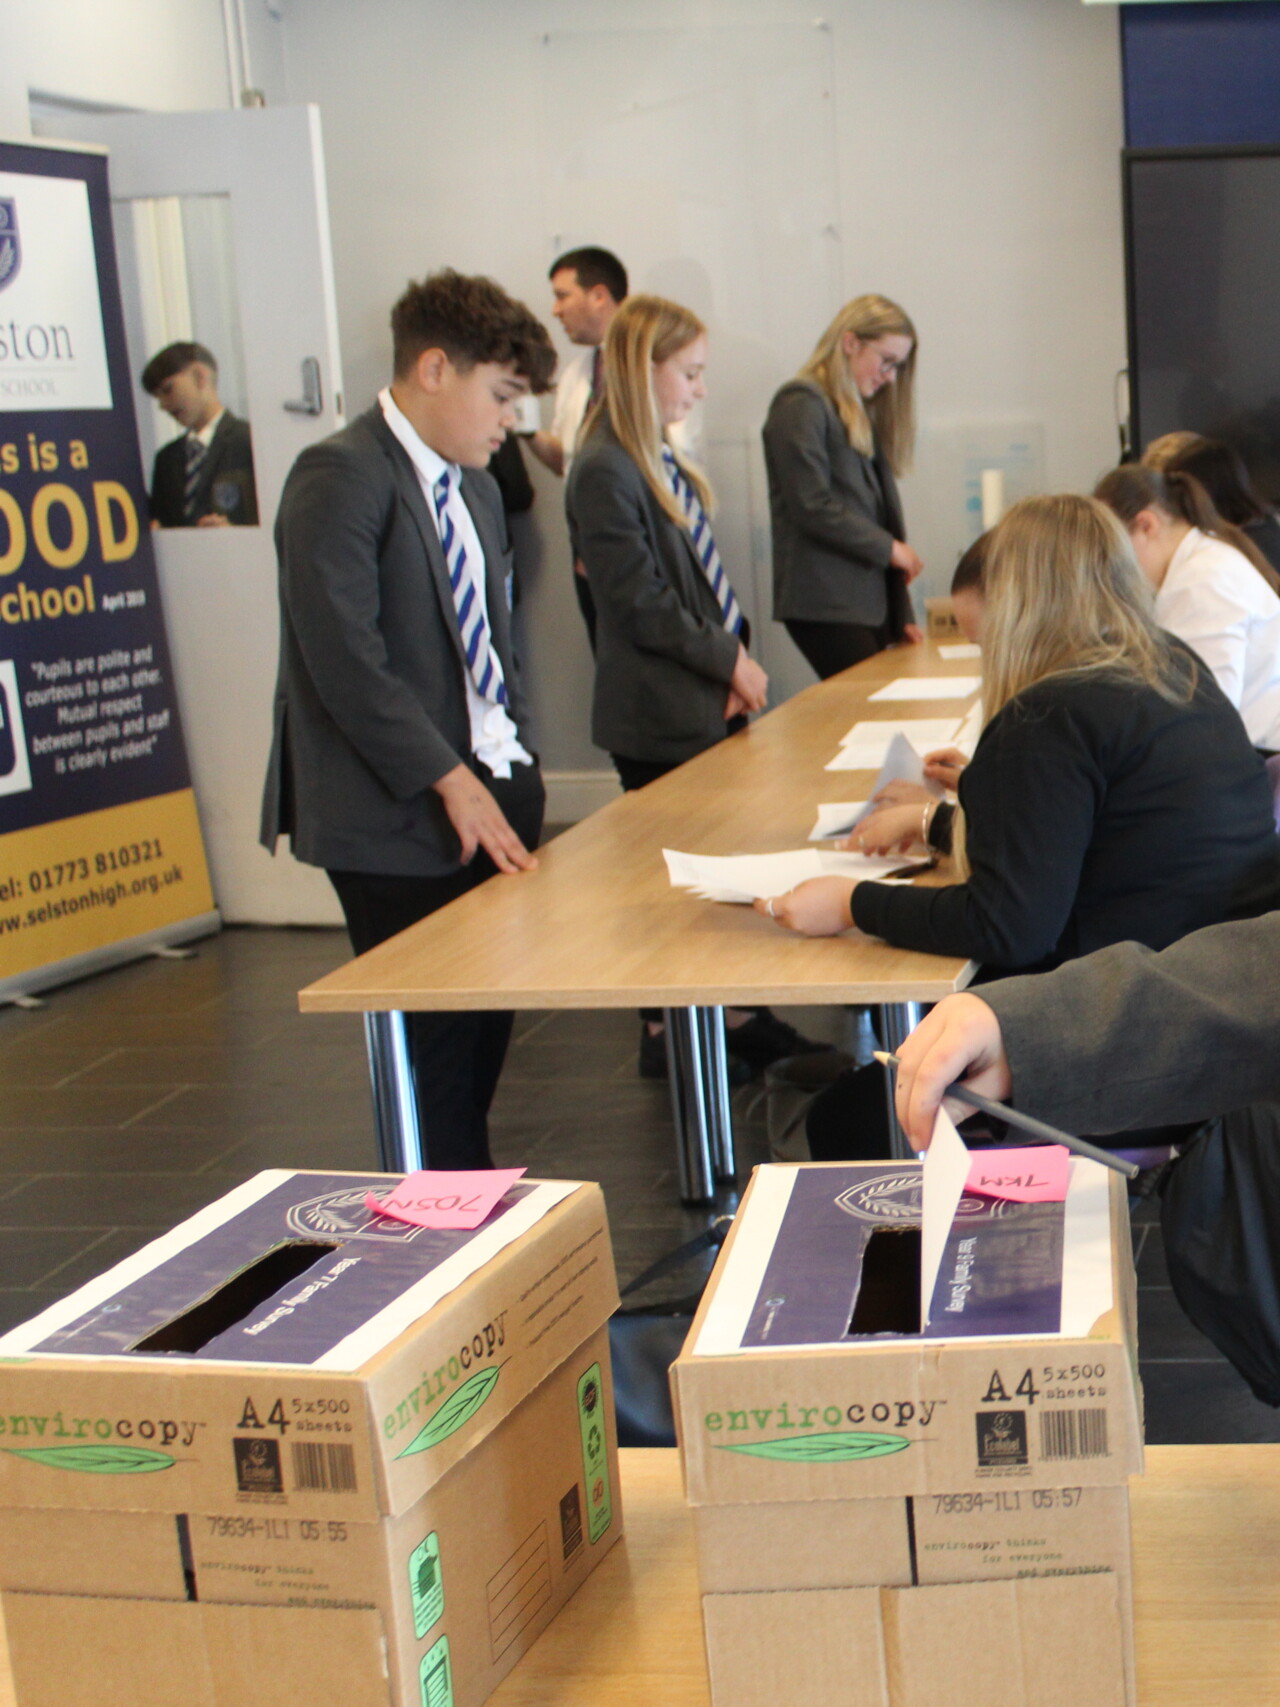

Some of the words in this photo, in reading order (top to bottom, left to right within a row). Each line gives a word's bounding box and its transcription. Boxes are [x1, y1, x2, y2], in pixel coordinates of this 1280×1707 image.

[27, 432, 59, 472] is
[69, 439, 89, 470] a
[75, 656, 95, 675] are
[97, 649, 131, 675] polite
[133, 644, 153, 665] and
[25, 682, 84, 708] courteous
[86, 679, 99, 696] to
[101, 672, 130, 694] each
[57, 700, 98, 726] Mutual
[99, 693, 143, 718] respect
[32, 729, 83, 756] between
[85, 720, 120, 748] pupils
[122, 714, 145, 737] and
[146, 707, 170, 731] staff
[54, 755, 67, 775] is
[68, 747, 109, 771] clearly
[29, 857, 89, 893] 01773
[95, 838, 163, 874] 810321
[383, 1310, 508, 1440] envirocopy
[981, 1368, 1040, 1405] A4
[1043, 1364, 1105, 1382] 5x500
[292, 1398, 350, 1415] 5x500
[1046, 1385, 1107, 1399] sheets
[236, 1396, 291, 1436] A4
[296, 1418, 352, 1432] sheets
[704, 1400, 940, 1432] envirocopy
[1032, 1487, 1083, 1509] 05:57
[1009, 1551, 1063, 1564] everyone
